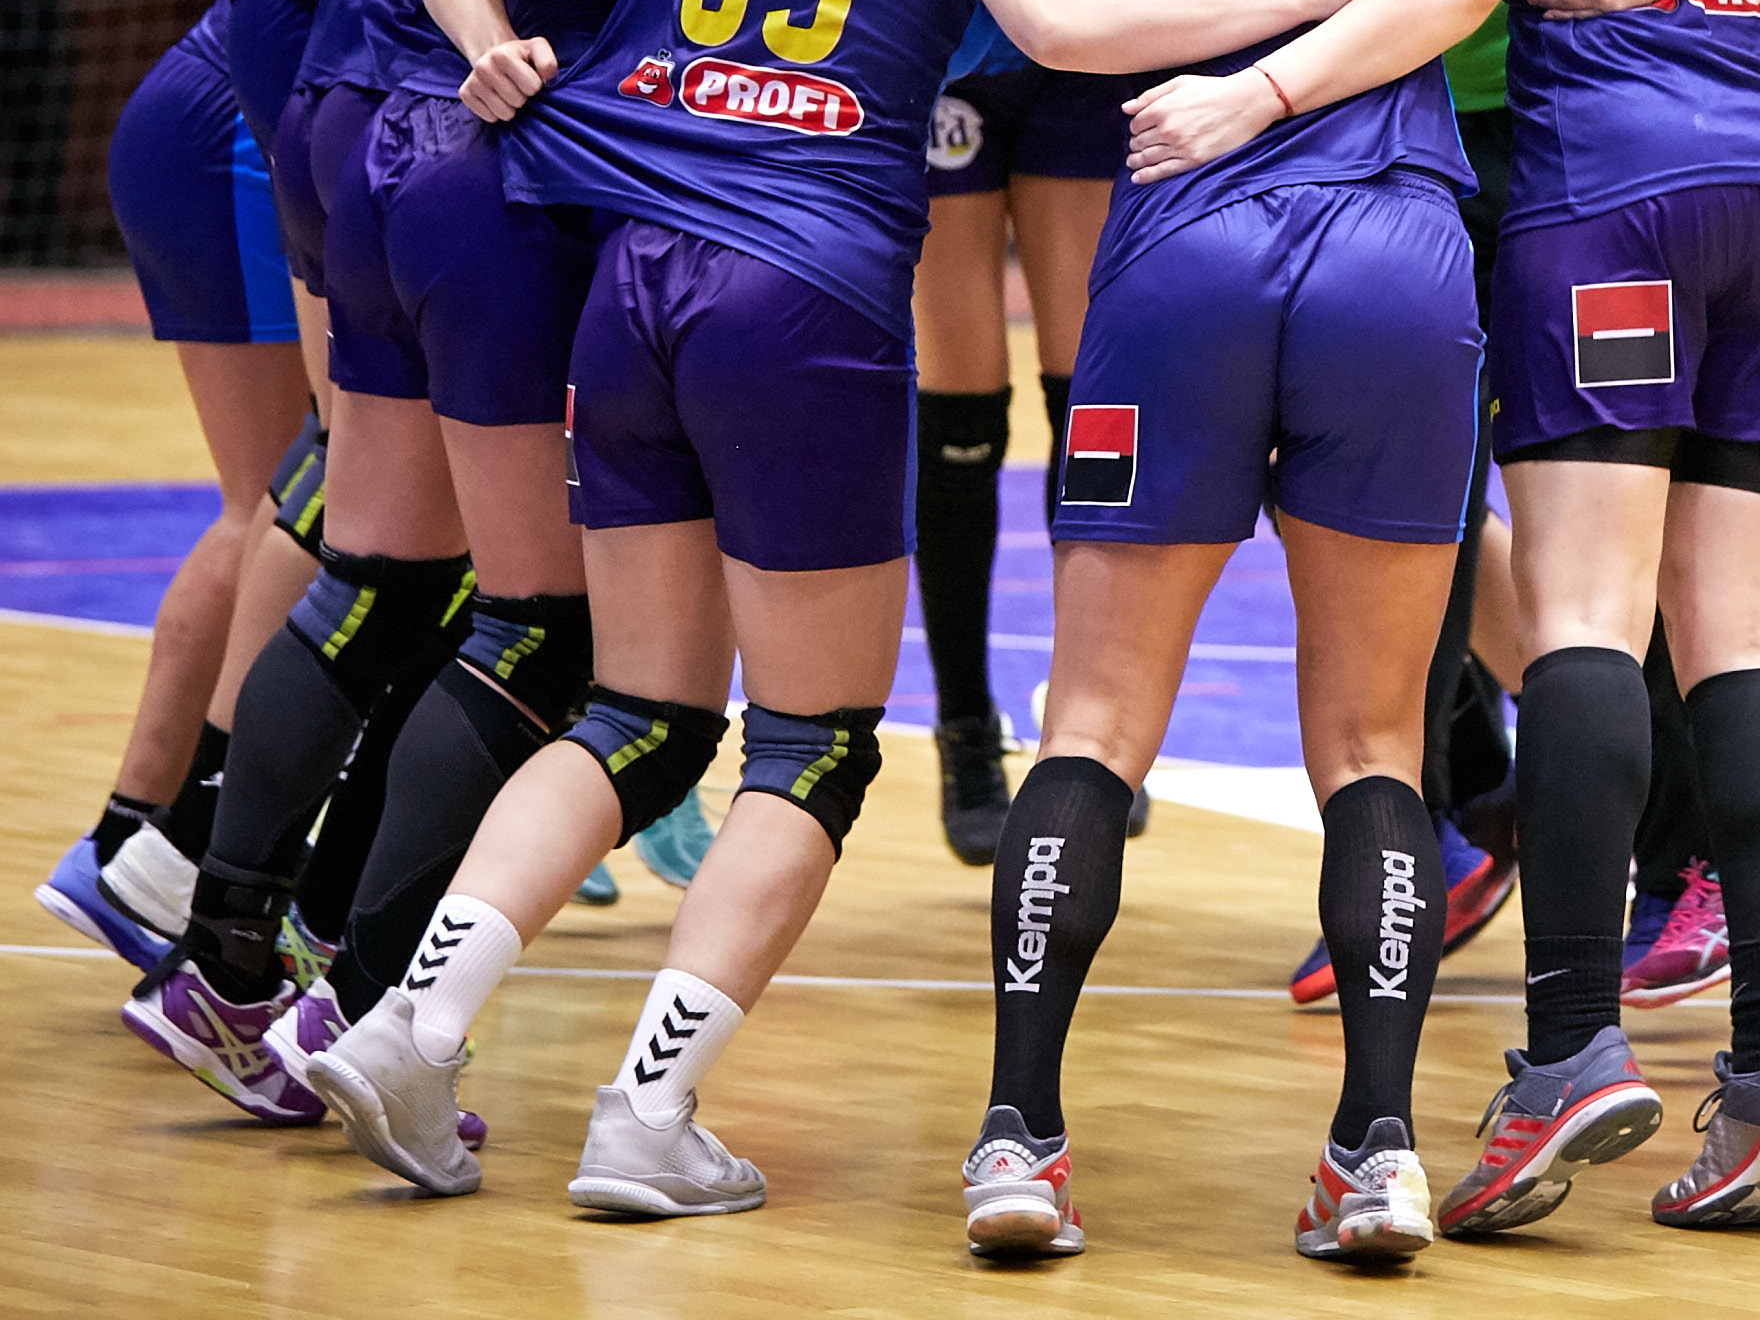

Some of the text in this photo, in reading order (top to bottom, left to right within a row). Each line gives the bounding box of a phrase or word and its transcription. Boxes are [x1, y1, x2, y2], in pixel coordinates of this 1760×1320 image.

[694, 69, 842, 130] PROFI
[1004, 836, 1070, 994] Kempa
[1369, 849, 1427, 1001] Kempa
